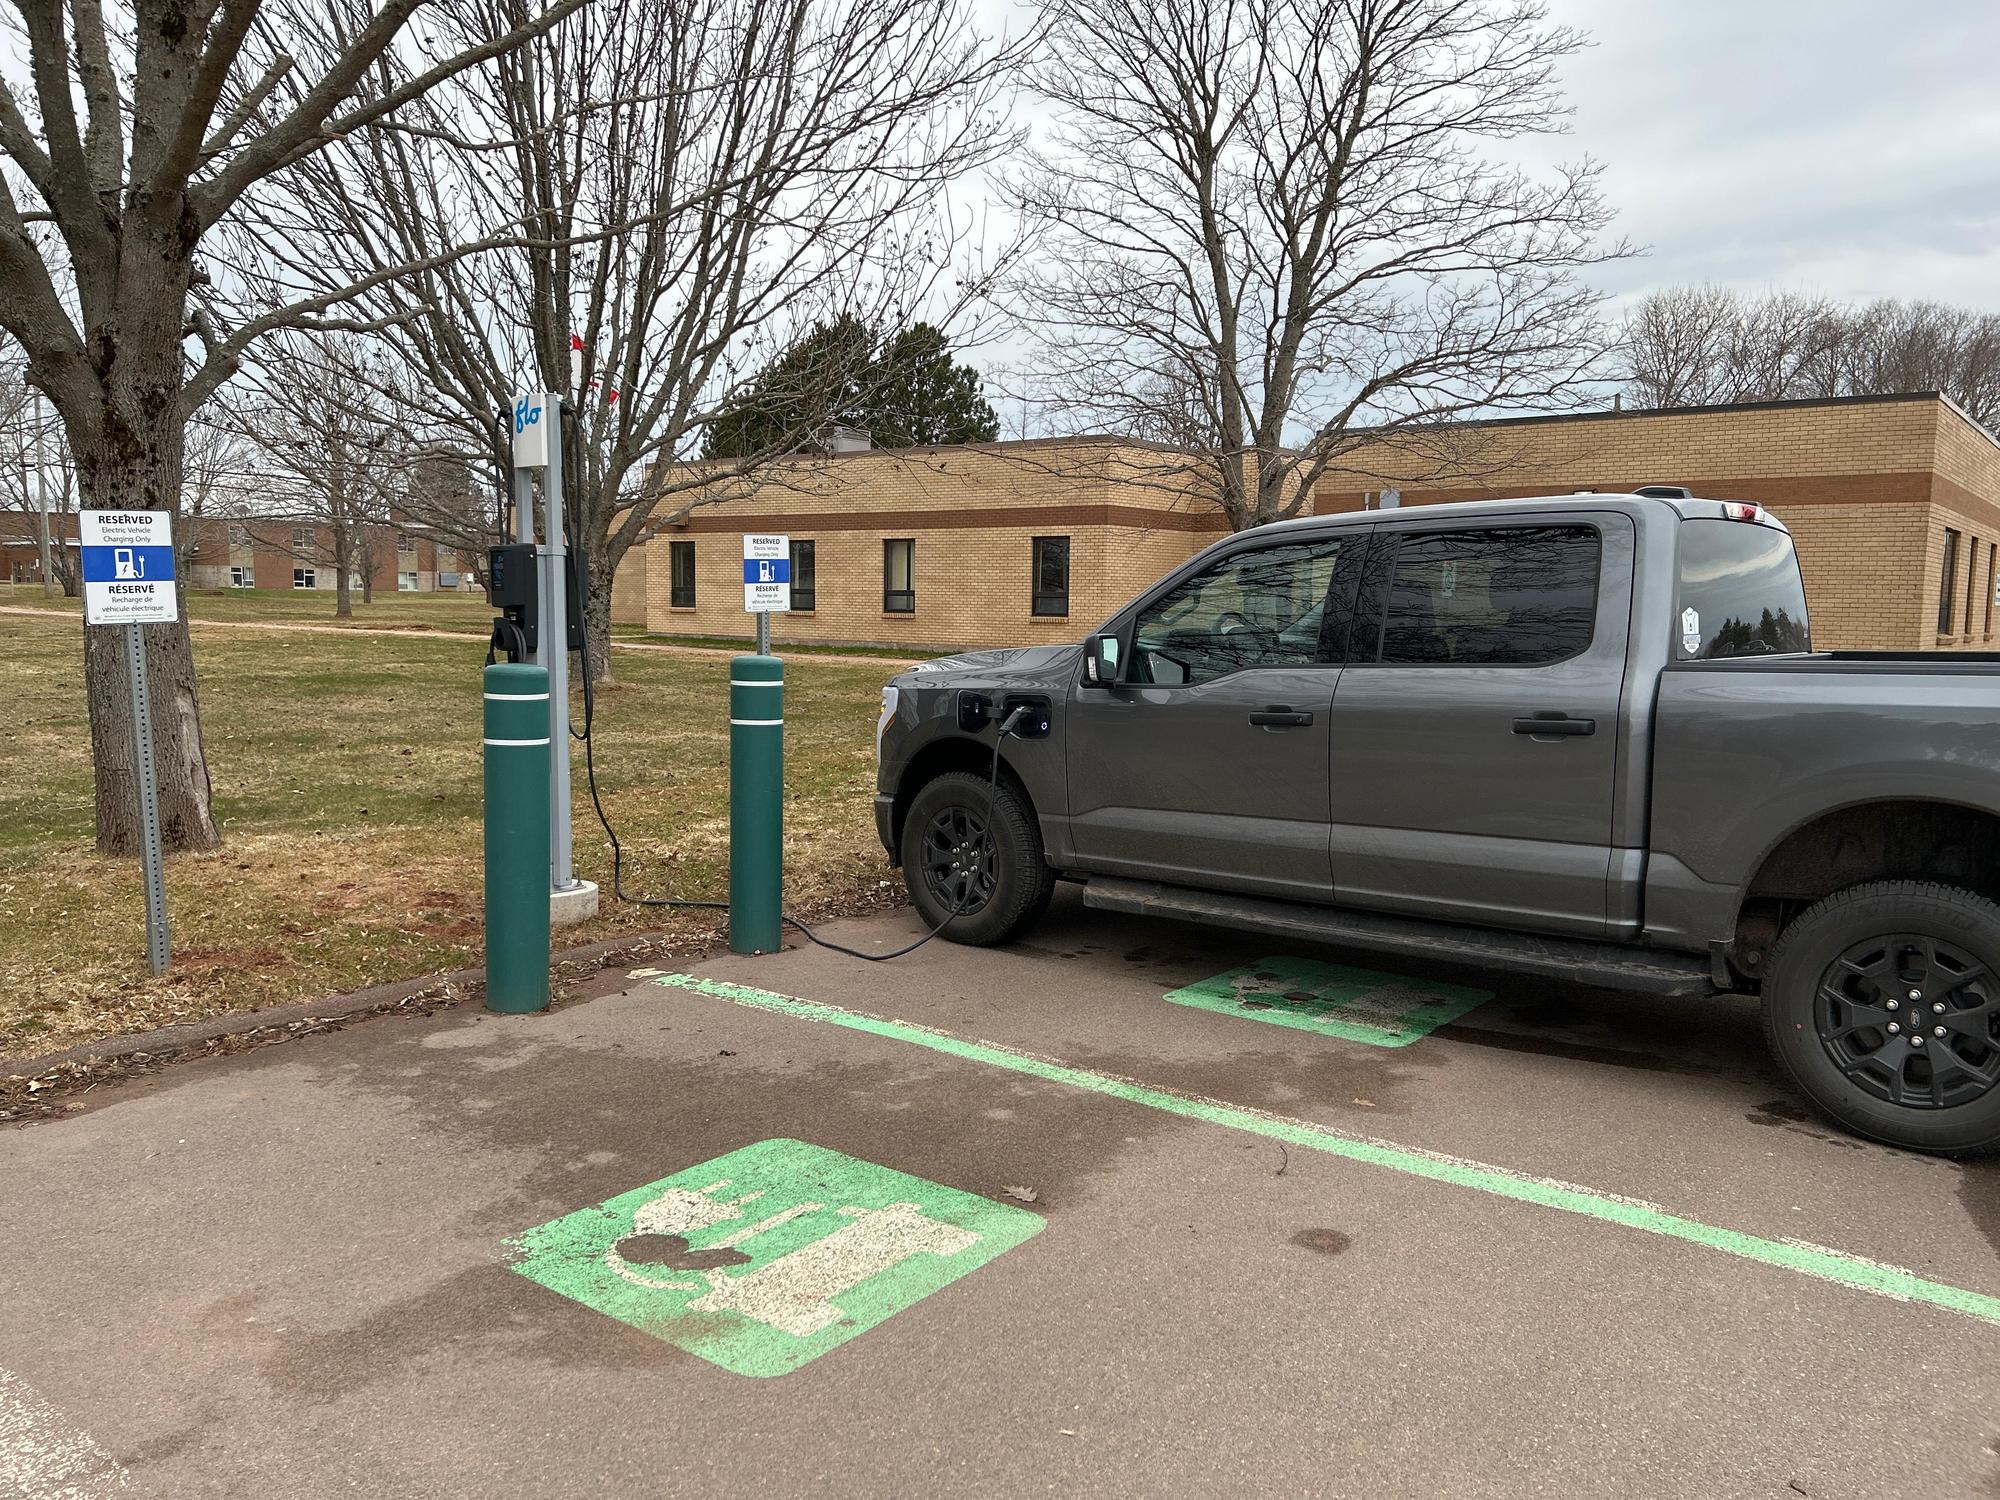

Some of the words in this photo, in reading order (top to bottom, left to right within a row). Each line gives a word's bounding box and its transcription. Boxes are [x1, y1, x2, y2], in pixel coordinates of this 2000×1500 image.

[516, 395, 541, 433] flo
[98, 515, 153, 525] RESERVED
[103, 535, 134, 543] Charging
[135, 535, 152, 543] Only
[108, 583, 155, 594] RÉSERVÉ
[111, 596, 143, 604] Recharge
